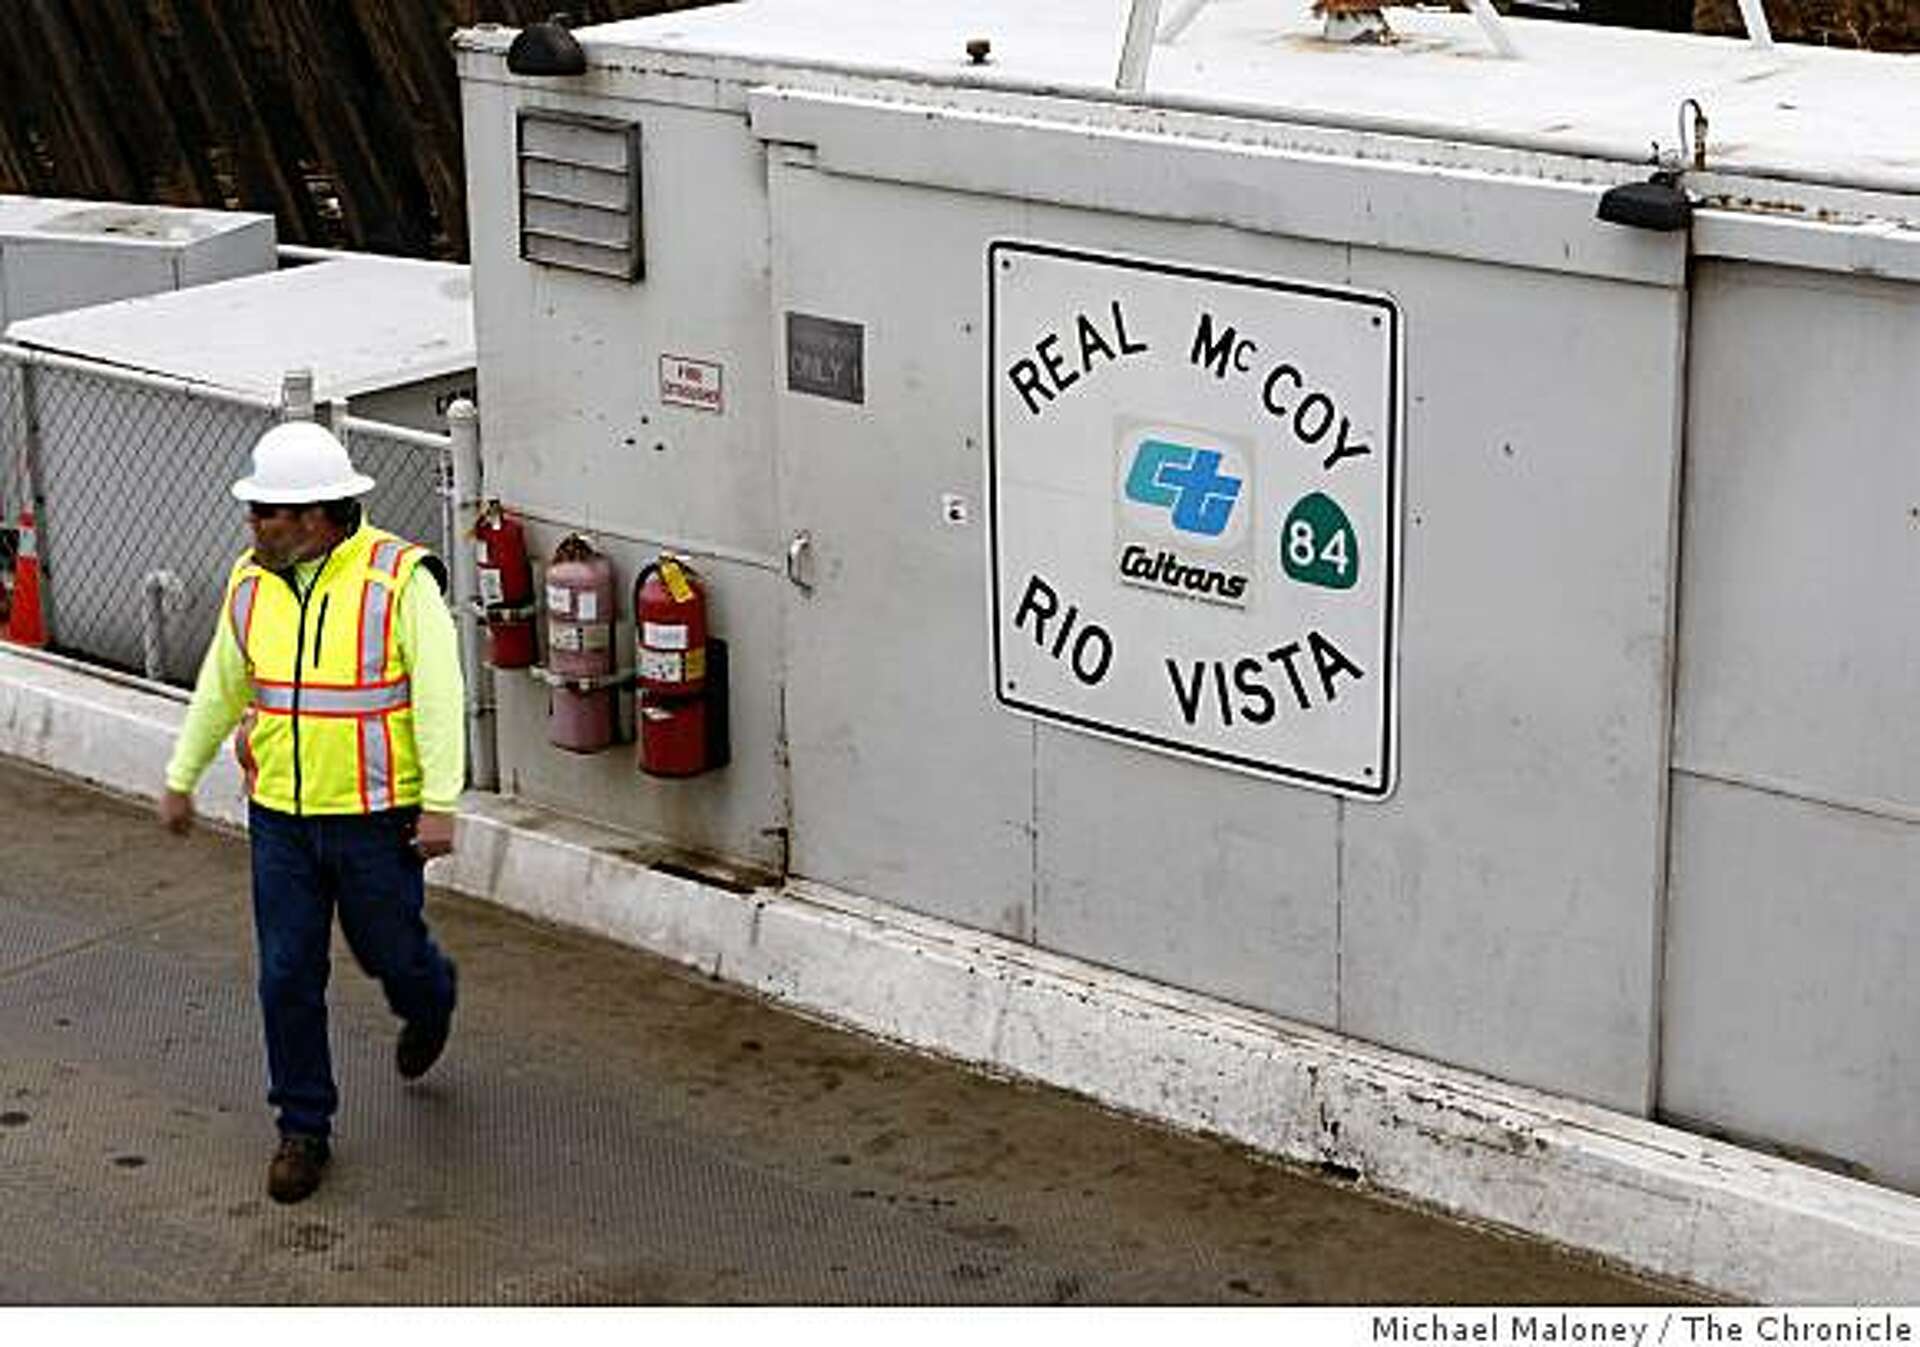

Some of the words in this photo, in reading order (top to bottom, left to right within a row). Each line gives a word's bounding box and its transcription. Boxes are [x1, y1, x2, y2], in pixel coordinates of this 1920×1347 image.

[1008, 300, 1148, 415] REAL
[1119, 545, 1249, 599] Caltrans
[1289, 520, 1349, 575] 84
[1014, 575, 1113, 687] RIO
[1165, 631, 1365, 726] VISTA
